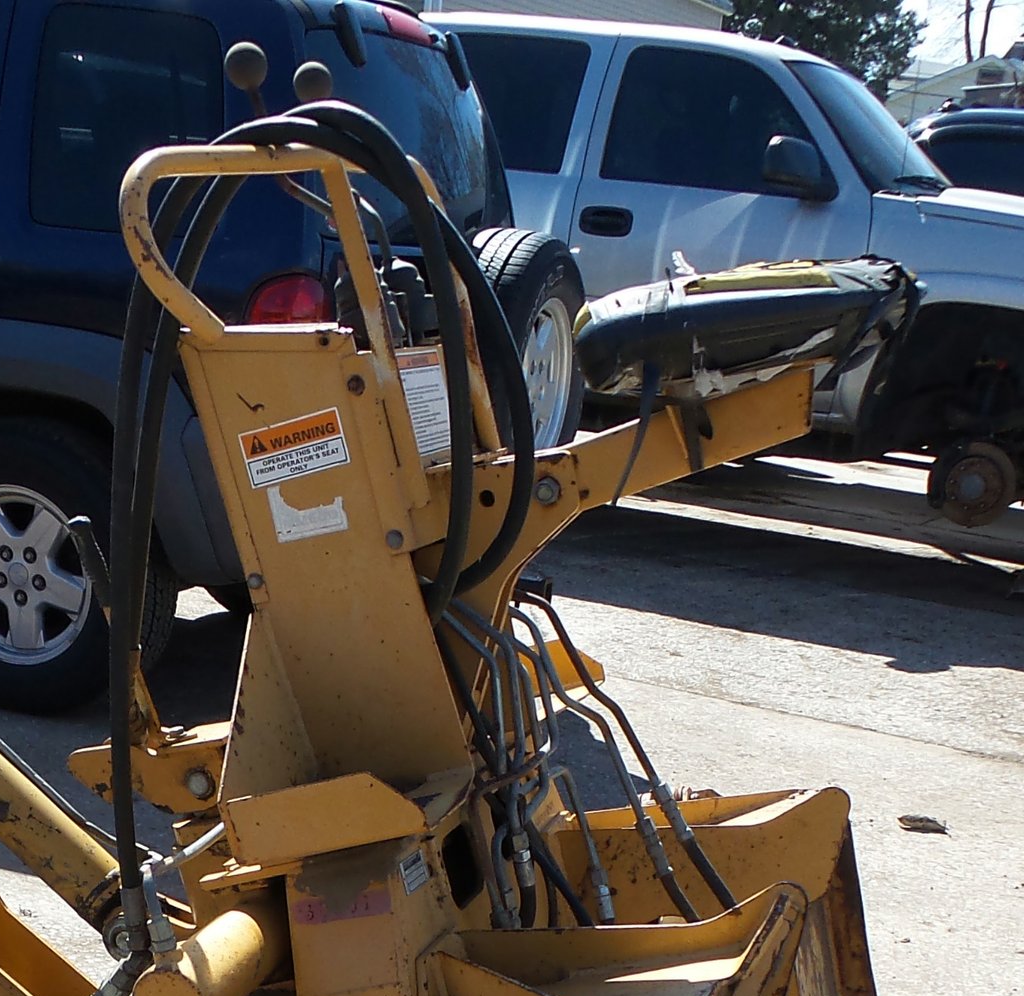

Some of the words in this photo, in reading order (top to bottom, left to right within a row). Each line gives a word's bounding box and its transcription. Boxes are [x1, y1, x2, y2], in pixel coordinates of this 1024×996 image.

[269, 422, 336, 449] WARNING
[256, 465, 276, 475] FROM
[277, 453, 320, 470] OPERATOR'S
[321, 447, 340, 458] SEAT
[262, 454, 294, 466] OPERATE
[295, 448, 312, 457] THIS
[312, 443, 329, 453] UNIT
[289, 463, 308, 473] ONLY
